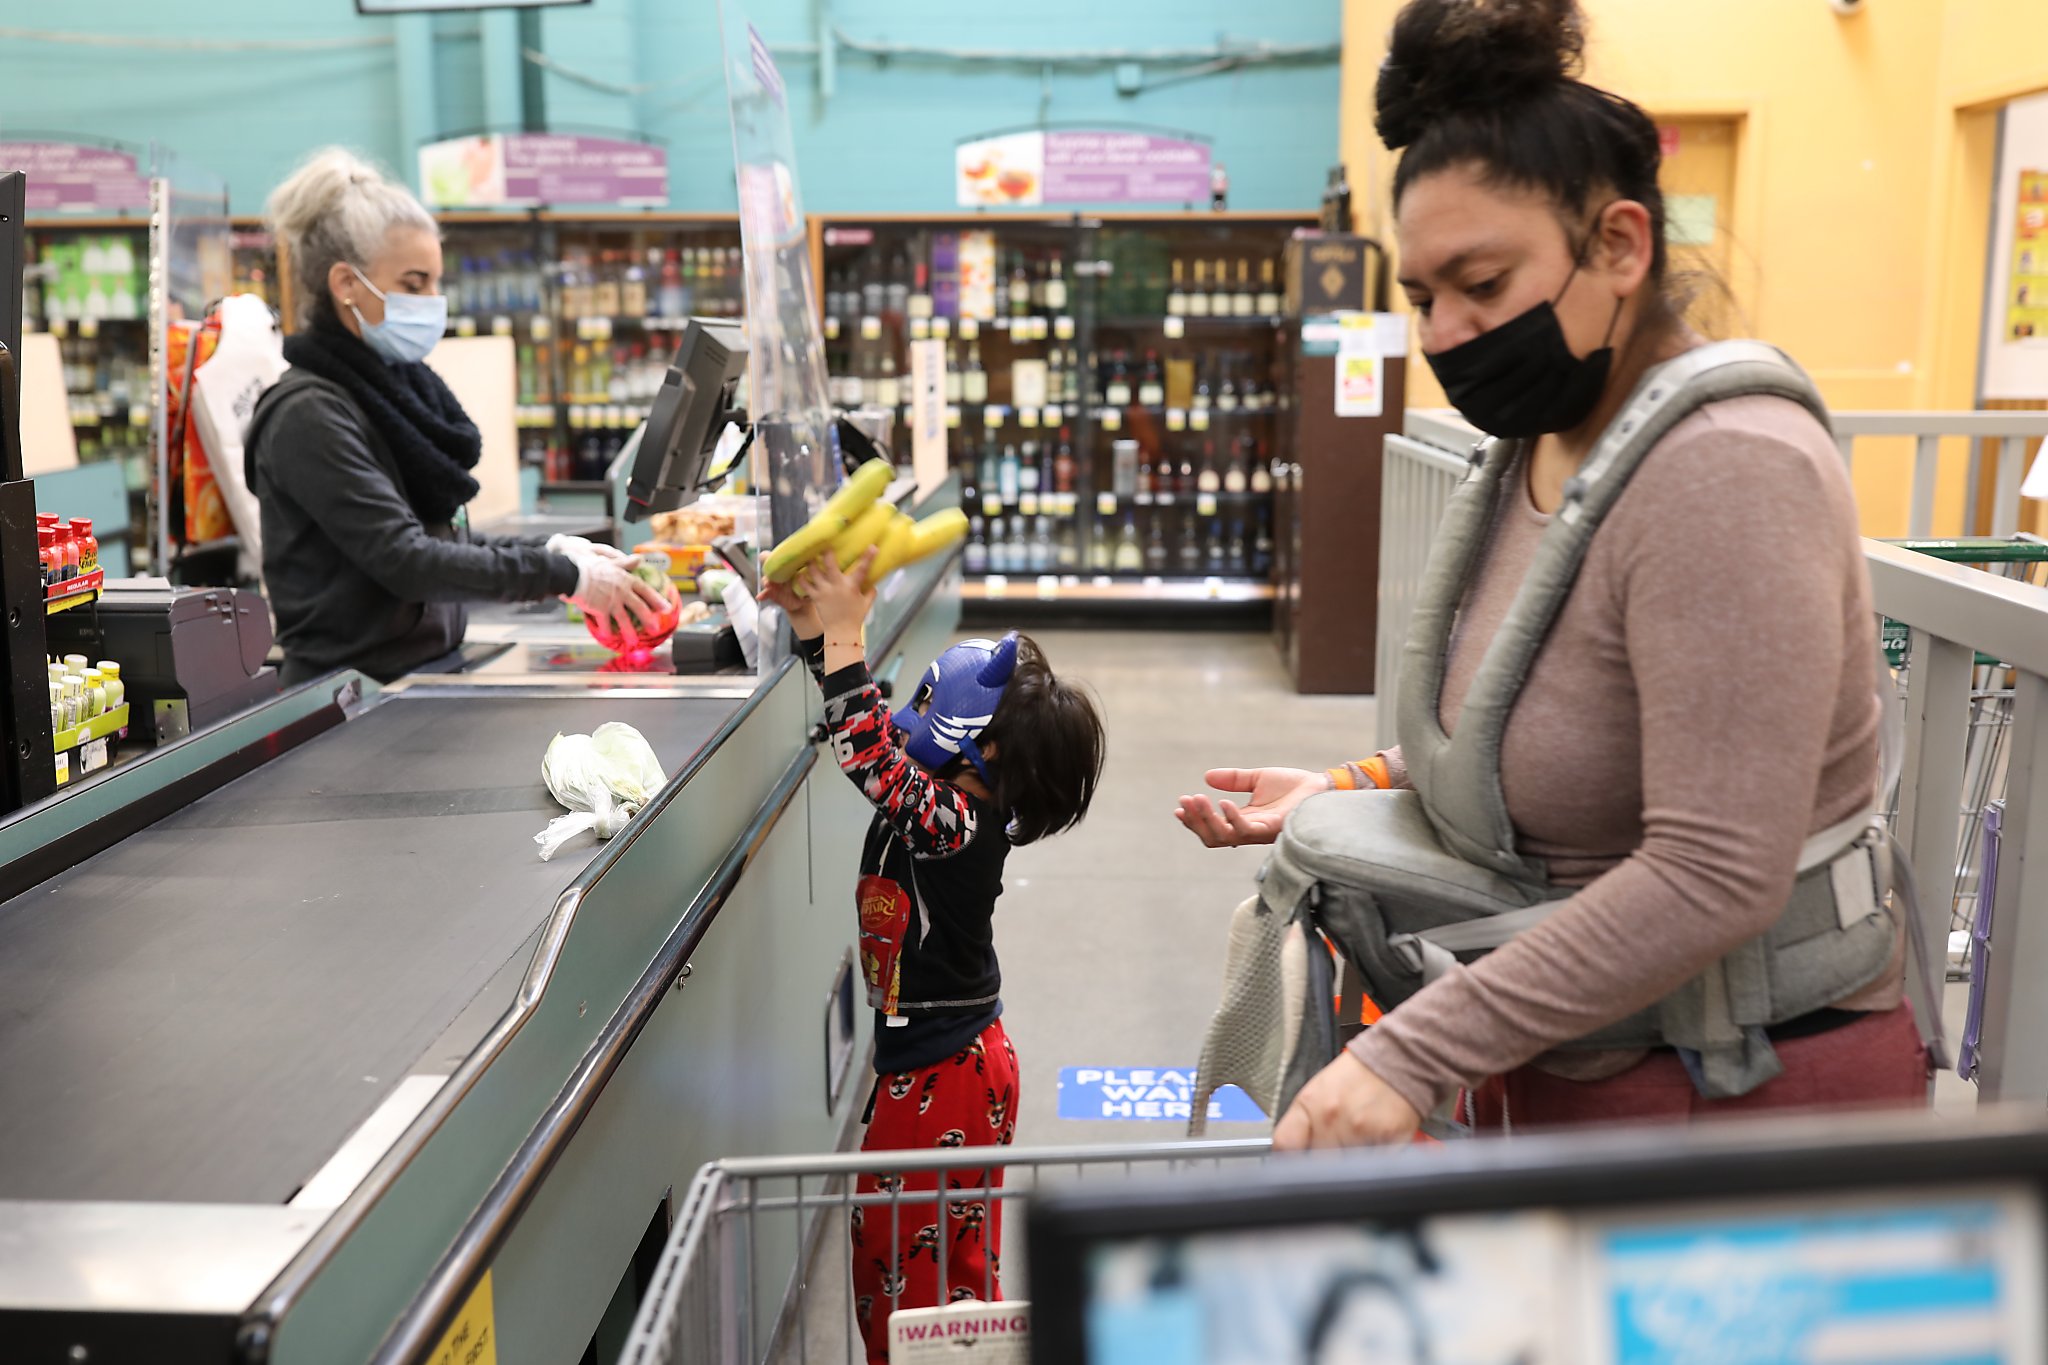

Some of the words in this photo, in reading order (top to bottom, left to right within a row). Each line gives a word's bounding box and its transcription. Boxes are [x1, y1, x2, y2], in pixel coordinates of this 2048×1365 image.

[66, 580, 89, 592] REGULAR
[79, 628, 105, 636] EPSN
[1076, 1069, 1197, 1086] PLEA
[1101, 1085, 1197, 1101] WAI
